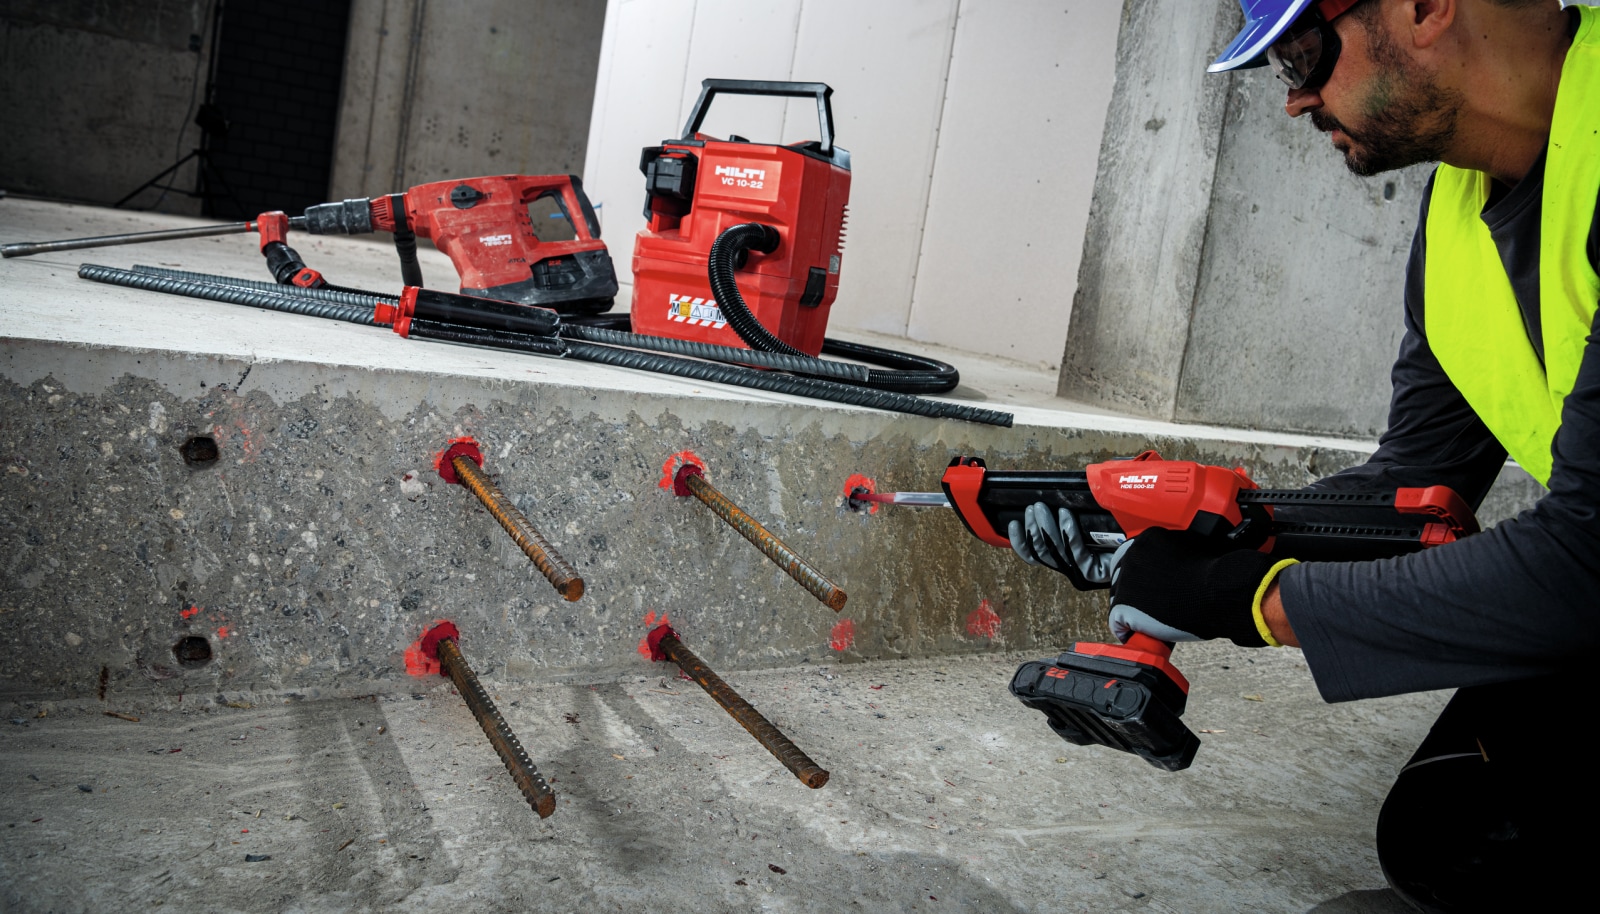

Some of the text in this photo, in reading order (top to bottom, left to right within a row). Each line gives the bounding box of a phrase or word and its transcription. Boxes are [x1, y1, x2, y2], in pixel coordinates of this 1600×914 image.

[715, 165, 765, 180] HILTI
[721, 177, 763, 189] VC 10-22
[479, 234, 511, 242] HILTI
[671, 302, 680, 314] M
[1119, 475, 1158, 483] HILTI
[1045, 667, 1069, 679] 22
